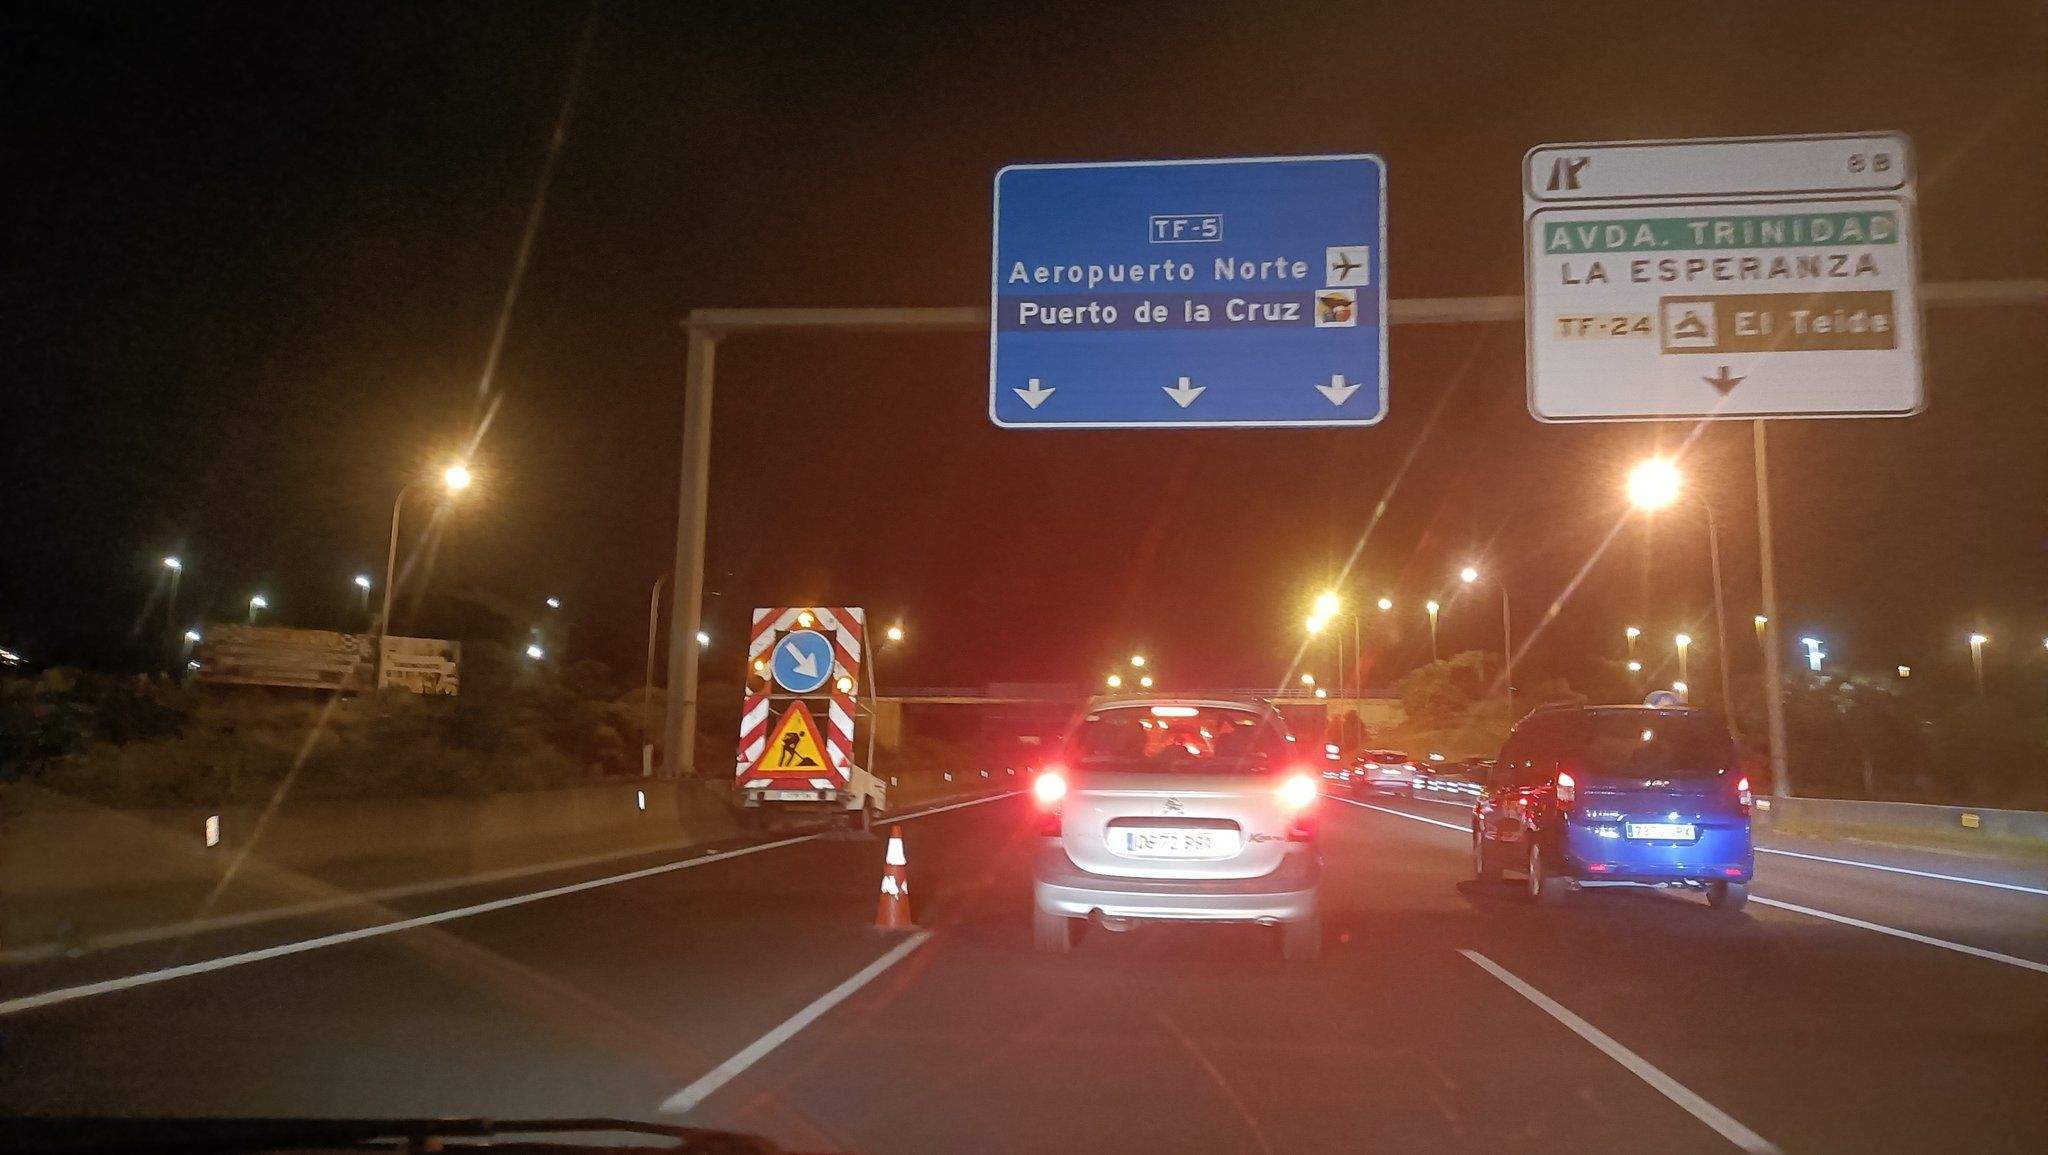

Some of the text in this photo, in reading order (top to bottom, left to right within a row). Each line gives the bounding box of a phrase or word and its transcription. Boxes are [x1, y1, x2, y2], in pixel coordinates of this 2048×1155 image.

[1154, 218, 1219, 240] TF-5
[1549, 214, 1896, 251] AVDA. TRINIDAD
[1008, 256, 1310, 288] Aeropuerto Norte
[1560, 252, 1881, 286] LA ESPERANZA
[1018, 298, 1301, 325] Puerto de la Cruz
[1557, 315, 1653, 337] TF-24
[1733, 308, 1891, 337] El Teide
